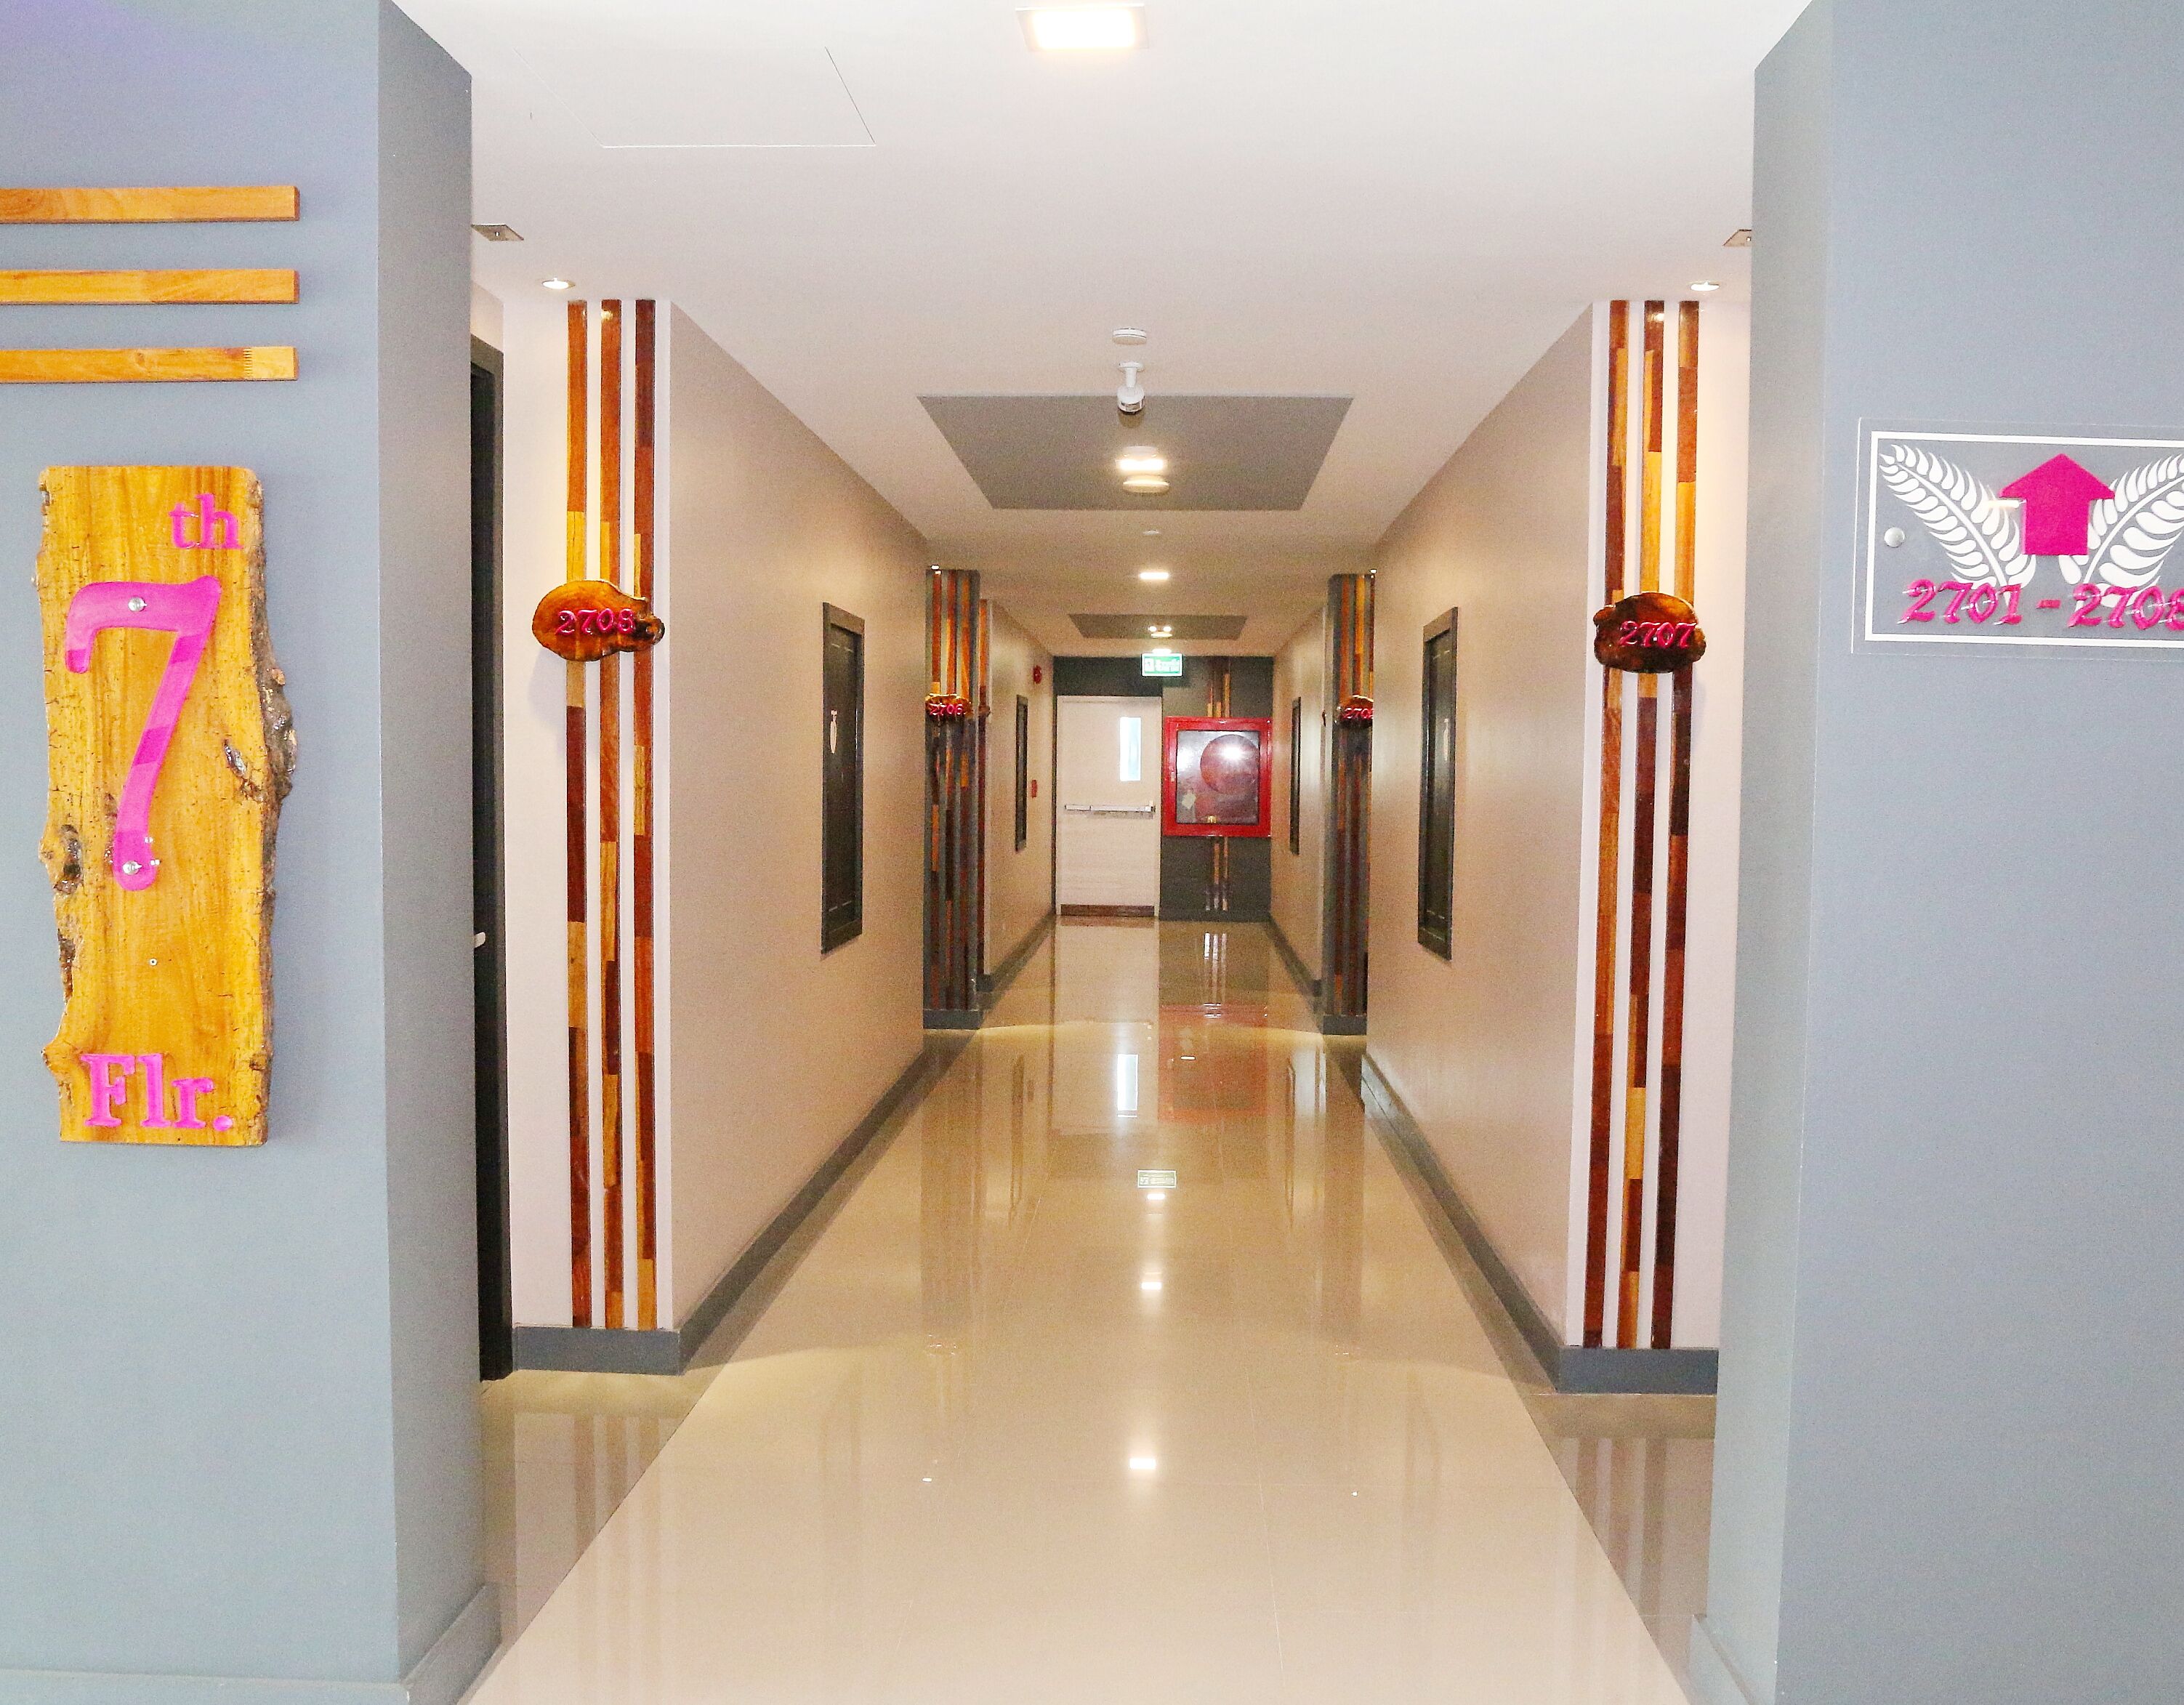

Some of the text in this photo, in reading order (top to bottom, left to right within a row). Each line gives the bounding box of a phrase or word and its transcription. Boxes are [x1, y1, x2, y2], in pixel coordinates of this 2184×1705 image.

[168, 493, 243, 550] th
[555, 608, 636, 636] 2708
[1898, 579, 2023, 625] 2701
[1619, 620, 1698, 649] 2707
[65, 575, 222, 892] 7
[80, 1052, 233, 1132] Flr.
